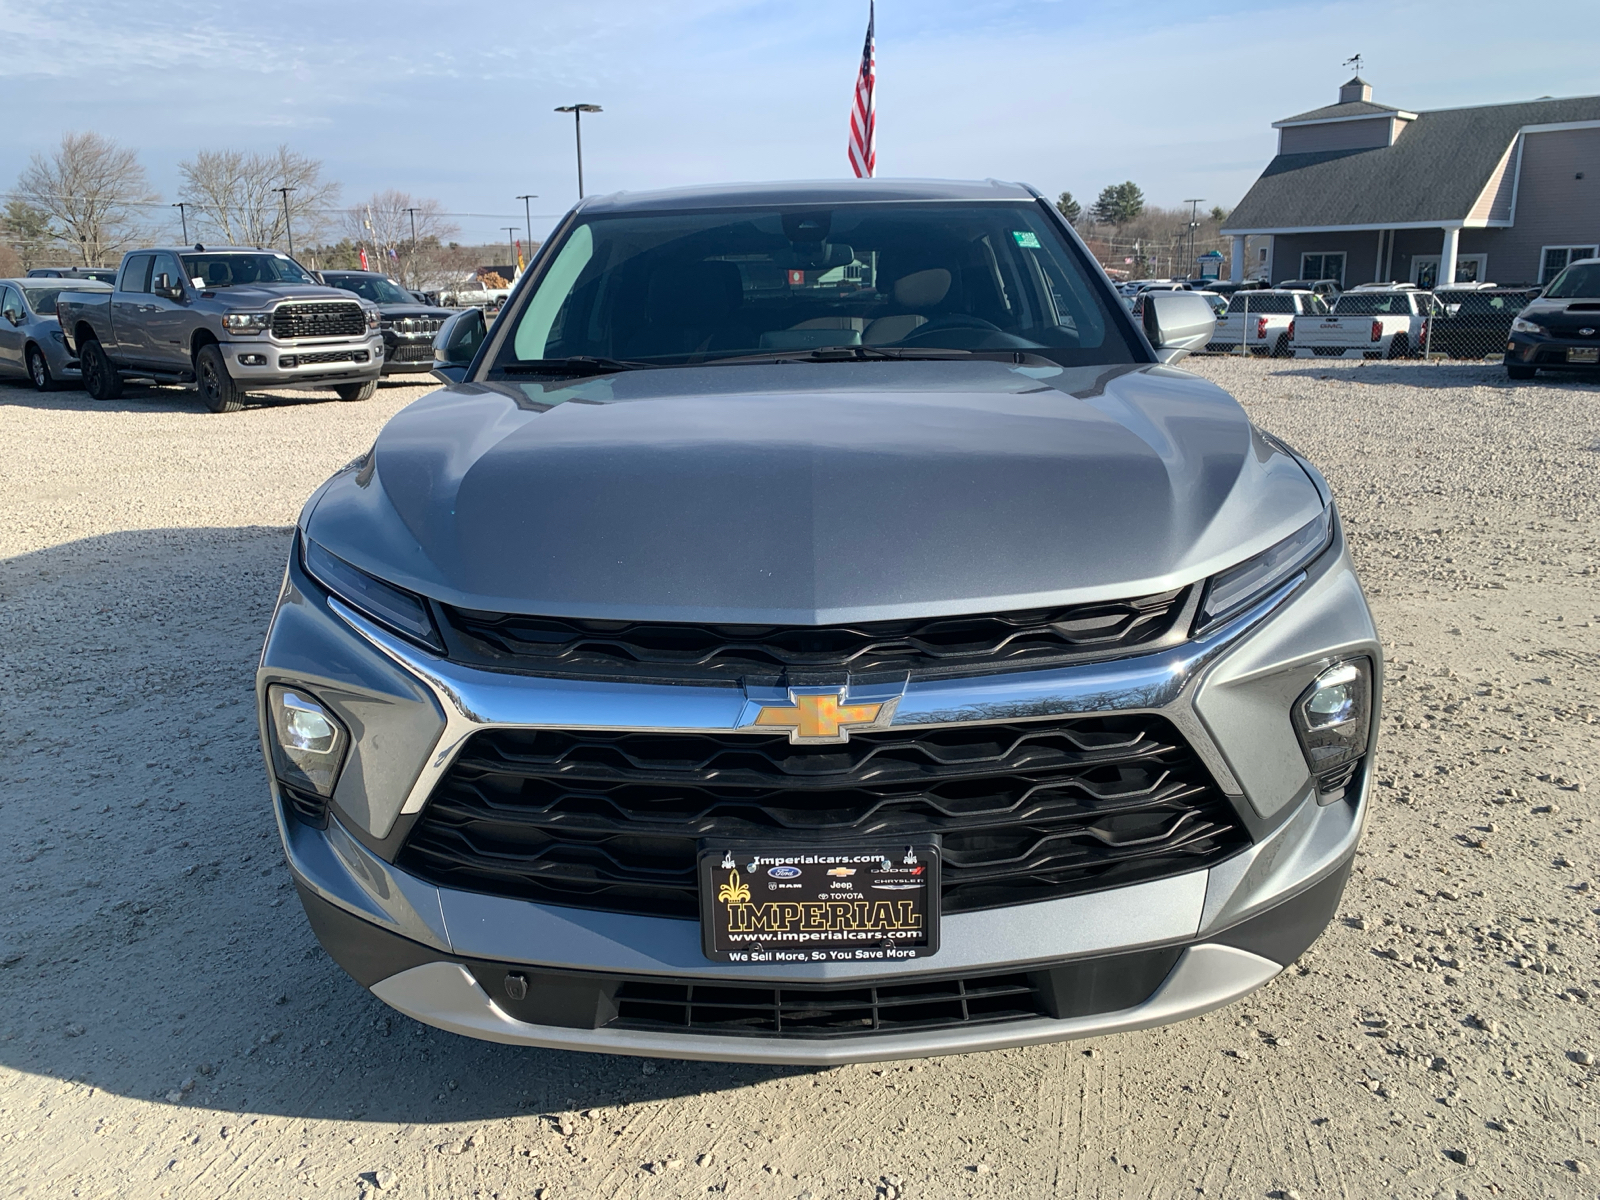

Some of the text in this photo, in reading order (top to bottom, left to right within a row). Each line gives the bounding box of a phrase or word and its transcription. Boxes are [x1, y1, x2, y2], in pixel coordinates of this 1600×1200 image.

[753, 855, 885, 867] Imperialcars.com
[830, 881, 852, 890] Jeep
[728, 901, 923, 932] IMPERIAL
[728, 930, 923, 942] www.imperialcars.com
[729, 949, 916, 962] We Sell More, So You Save More
